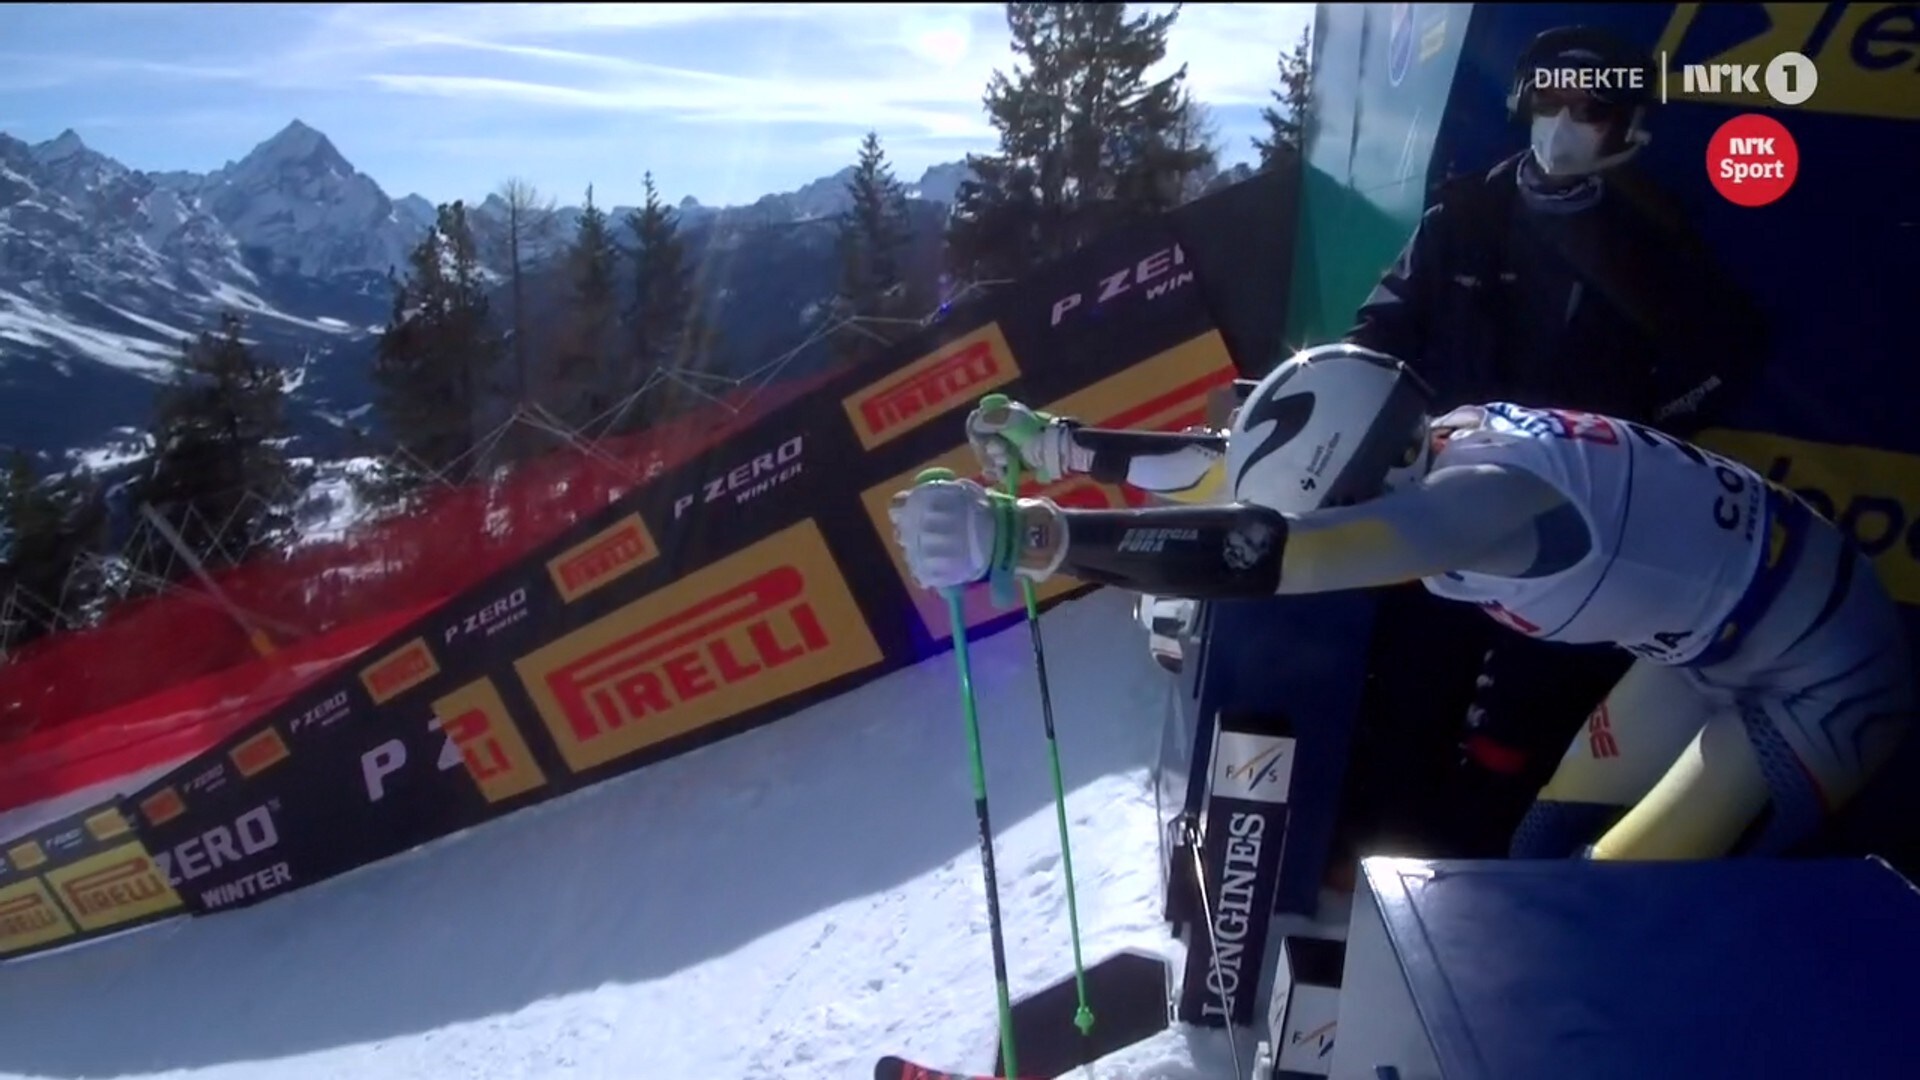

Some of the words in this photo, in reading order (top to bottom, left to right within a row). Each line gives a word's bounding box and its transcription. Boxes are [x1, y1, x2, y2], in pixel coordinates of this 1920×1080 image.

[1051, 293, 1082, 326] P
[1146, 270, 1194, 300] WIN
[674, 495, 693, 519] P
[703, 436, 803, 503] ZERO
[736, 464, 803, 504] WINTER
[1117, 539, 1165, 552] PURA
[444, 625, 458, 643] P
[464, 588, 527, 634] ZERO
[544, 564, 830, 742] PIRELLI
[361, 739, 407, 802] P
[201, 861, 292, 908] WINTER
[1202, 812, 1266, 1018] LONGINES
